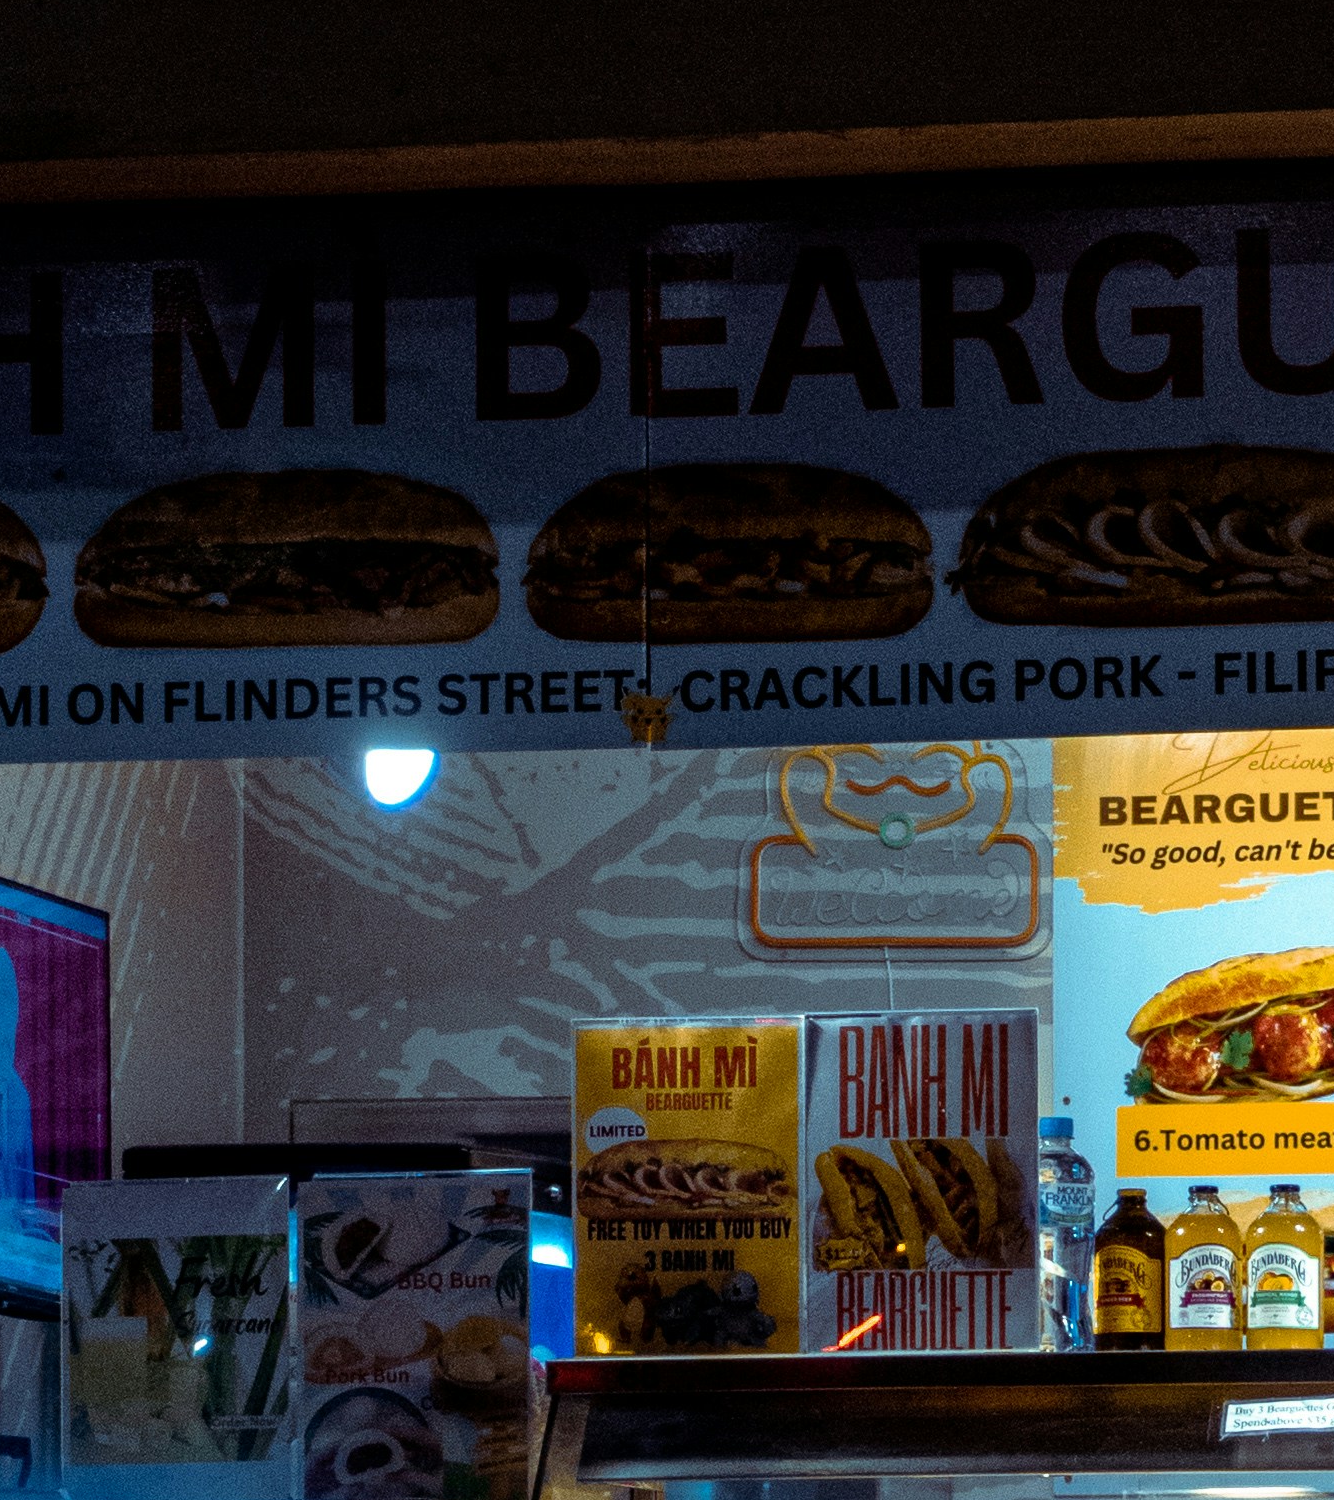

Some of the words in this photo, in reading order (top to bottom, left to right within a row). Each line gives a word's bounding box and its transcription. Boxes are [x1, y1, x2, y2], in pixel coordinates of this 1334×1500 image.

[69, 682, 145, 726] ON
[164, 675, 421, 724] FLINDERS
[681, 661, 996, 711] CRACKLING
[1015, 654, 1160, 703] PORK
[1150, 841, 1228, 870] good,
[1235, 838, 1301, 862] can't
[612, 1037, 700, 1089] BÁNH
[714, 1035, 757, 1088] MÌ
[839, 1024, 946, 1139] BANH
[961, 1023, 1009, 1137] MI
[646, 1092, 733, 1111] BEARGUETTE
[589, 1124, 645, 1138] LIMITED
[588, 1219, 626, 1240] FREE
[632, 1219, 662, 1239] TOY
[669, 1218, 716, 1239] WHEN
[722, 1218, 754, 1239] YOU
[760, 1217, 791, 1239] BUY
[644, 1252, 656, 1271] 3
[662, 1251, 707, 1271] BANH
[712, 1251, 734, 1271] MI
[173, 1256, 268, 1300] Fresh
[397, 1273, 442, 1291] BBQ
[450, 1271, 491, 1290] Bun
[837, 1271, 1011, 1351] BEARGUETTE
